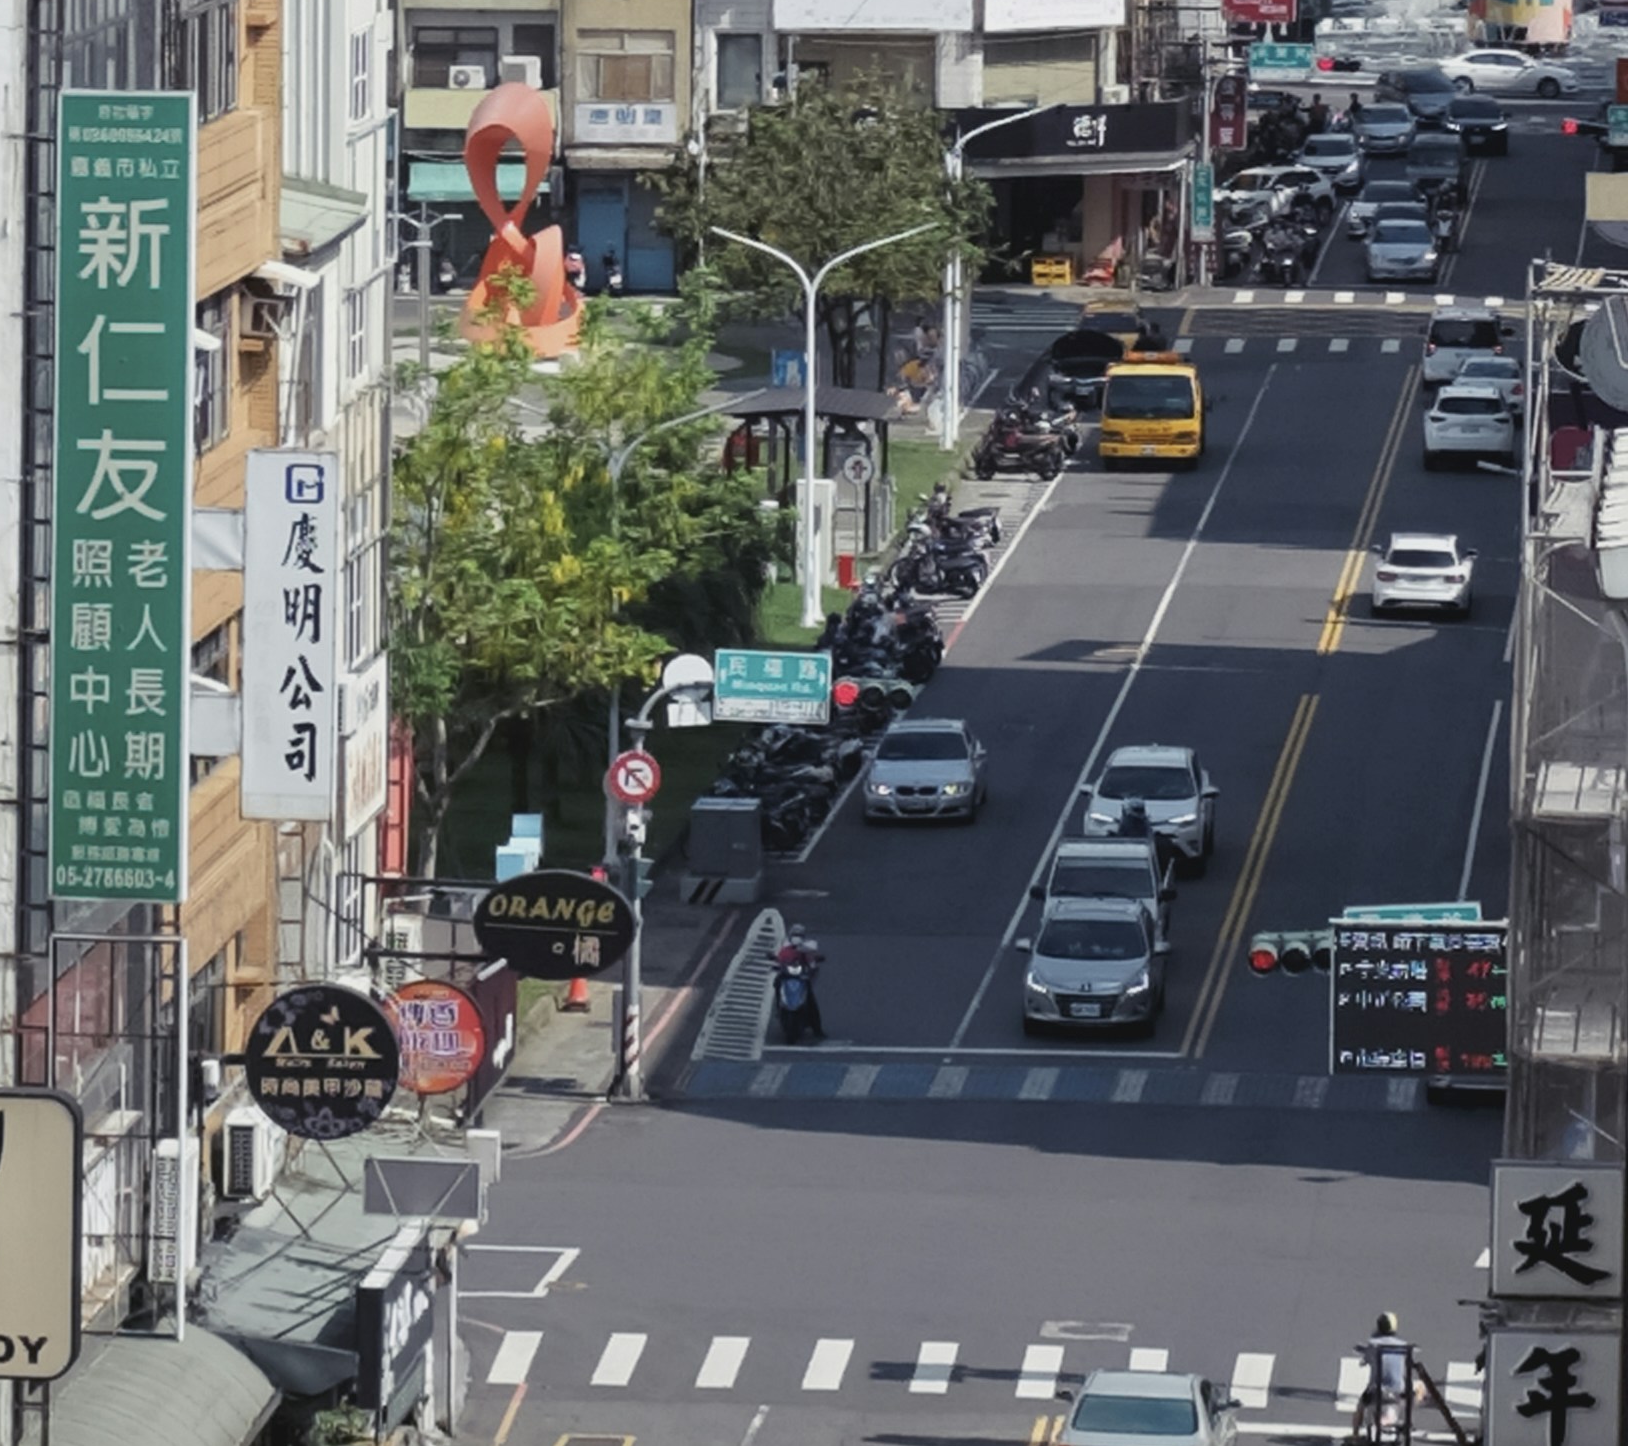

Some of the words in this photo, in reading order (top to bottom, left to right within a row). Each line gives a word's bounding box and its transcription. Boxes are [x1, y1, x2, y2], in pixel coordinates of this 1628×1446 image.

[75, 195, 171, 522] 新仁友
[68, 537, 114, 780] 照顧中心
[124, 539, 170, 782] 老人長期
[280, 512, 325, 784] 慶明公司
